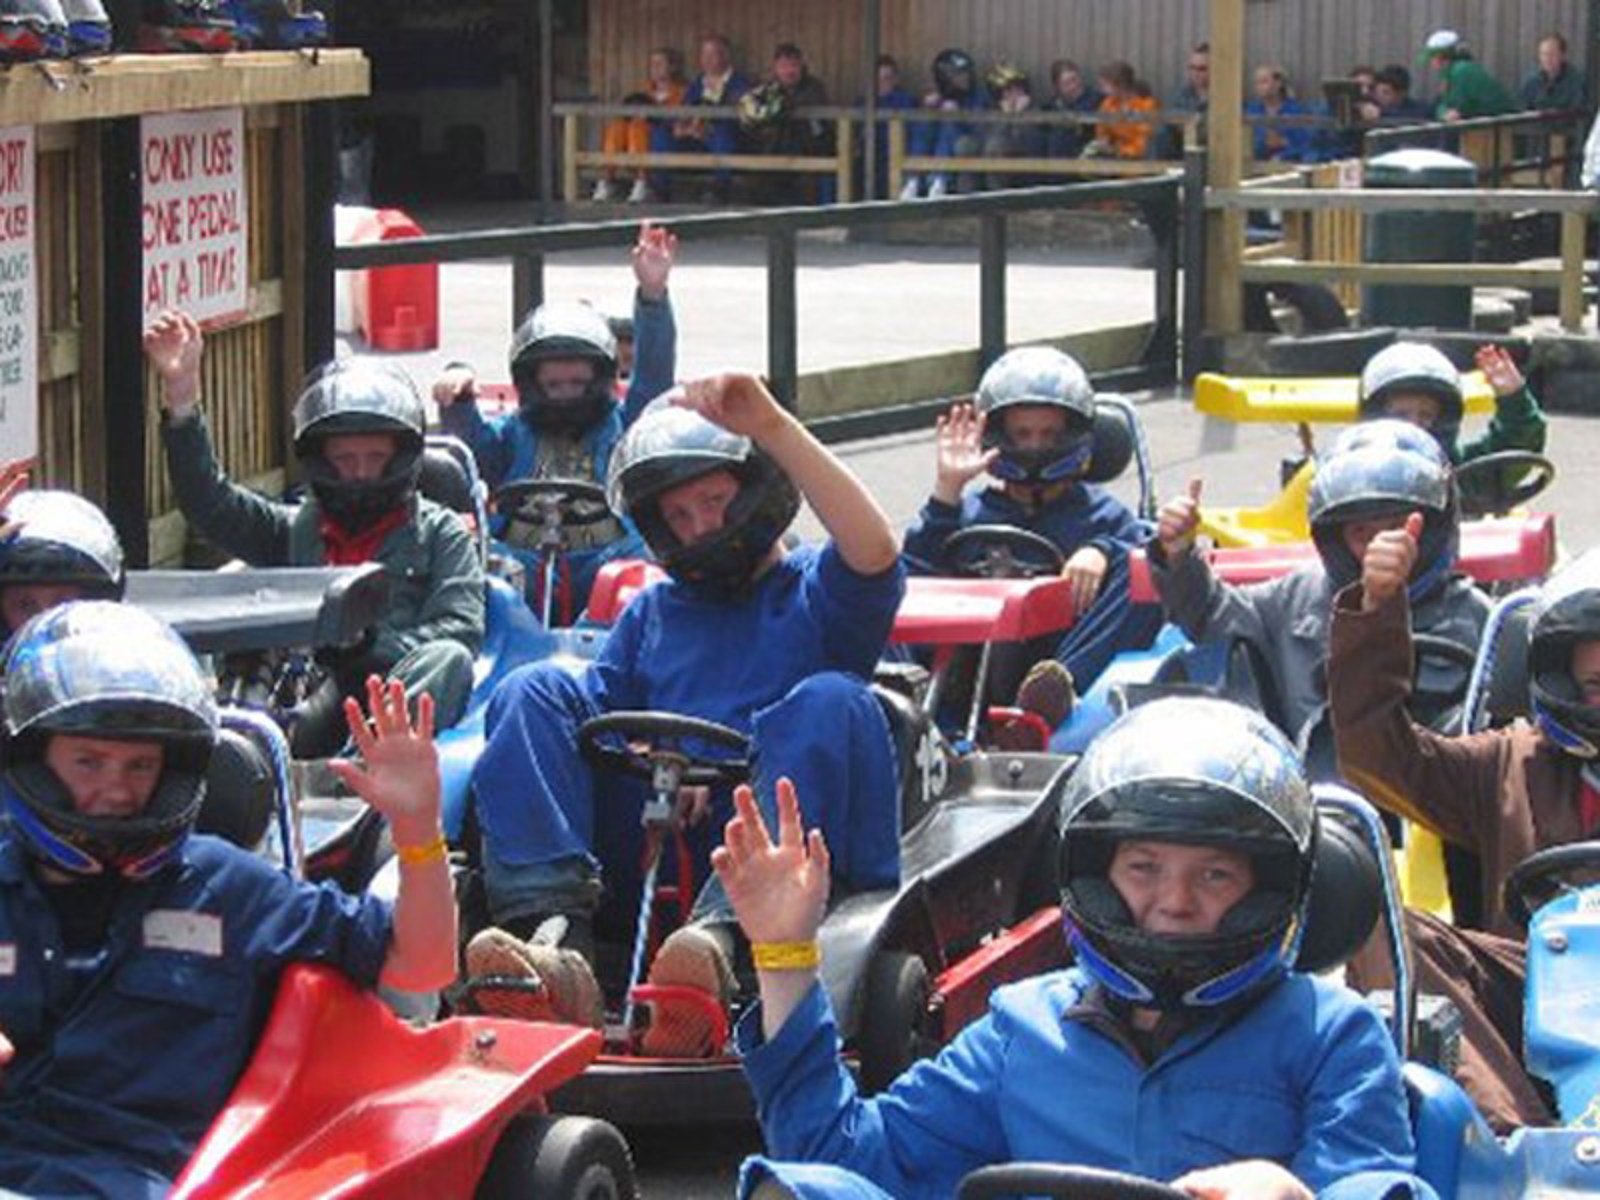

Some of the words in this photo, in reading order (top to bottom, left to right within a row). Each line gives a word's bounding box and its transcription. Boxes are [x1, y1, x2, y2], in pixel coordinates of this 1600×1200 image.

[146, 134, 194, 184] ONLY
[202, 129, 232, 177] USE
[142, 202, 181, 249] ONE
[188, 190, 240, 241] PEDAL
[145, 263, 169, 312] AT
[176, 259, 191, 304] A
[198, 247, 236, 298] TIME
